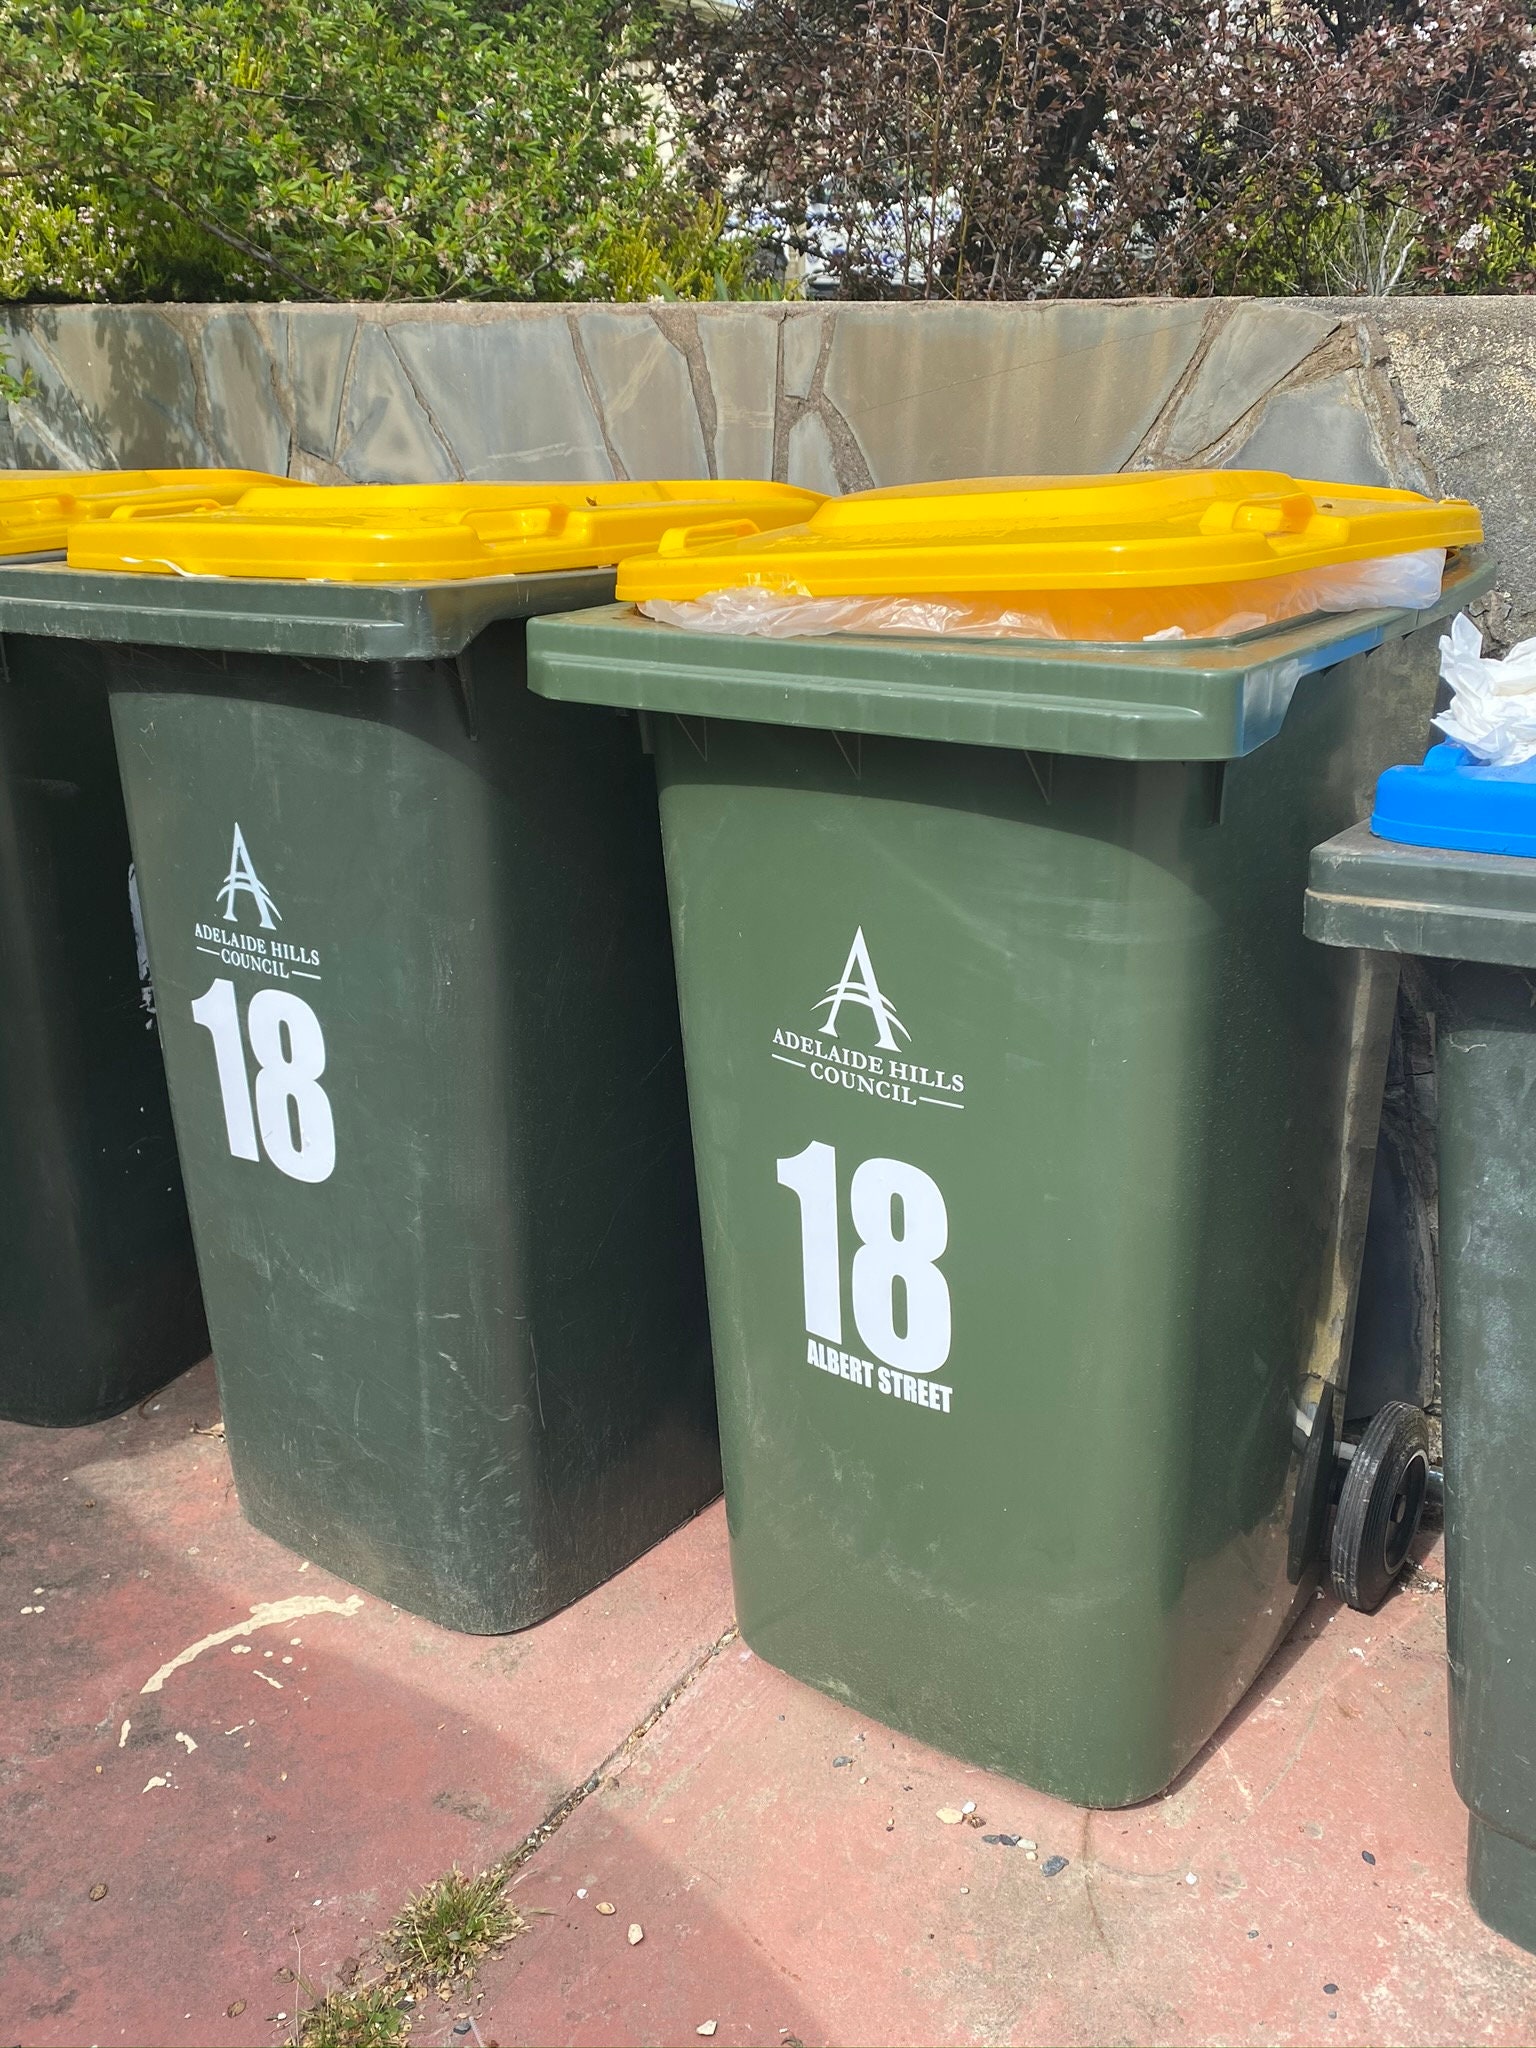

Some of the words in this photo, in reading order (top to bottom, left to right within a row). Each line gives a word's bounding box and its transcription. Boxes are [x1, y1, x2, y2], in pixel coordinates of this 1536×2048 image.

[194, 922, 267, 955] ADELAIDE
[270, 940, 321, 967] HILLS
[220, 947, 290, 979] COUNCIL
[190, 977, 337, 1184] 18
[772, 1027, 884, 1076] ADELAIDE
[888, 1059, 965, 1093] HILLS
[810, 1061, 918, 1106] COUNCIL
[776, 1139, 952, 1374] 18
[806, 1338, 875, 1389] ALBERT
[877, 1365, 954, 1414] STREET
